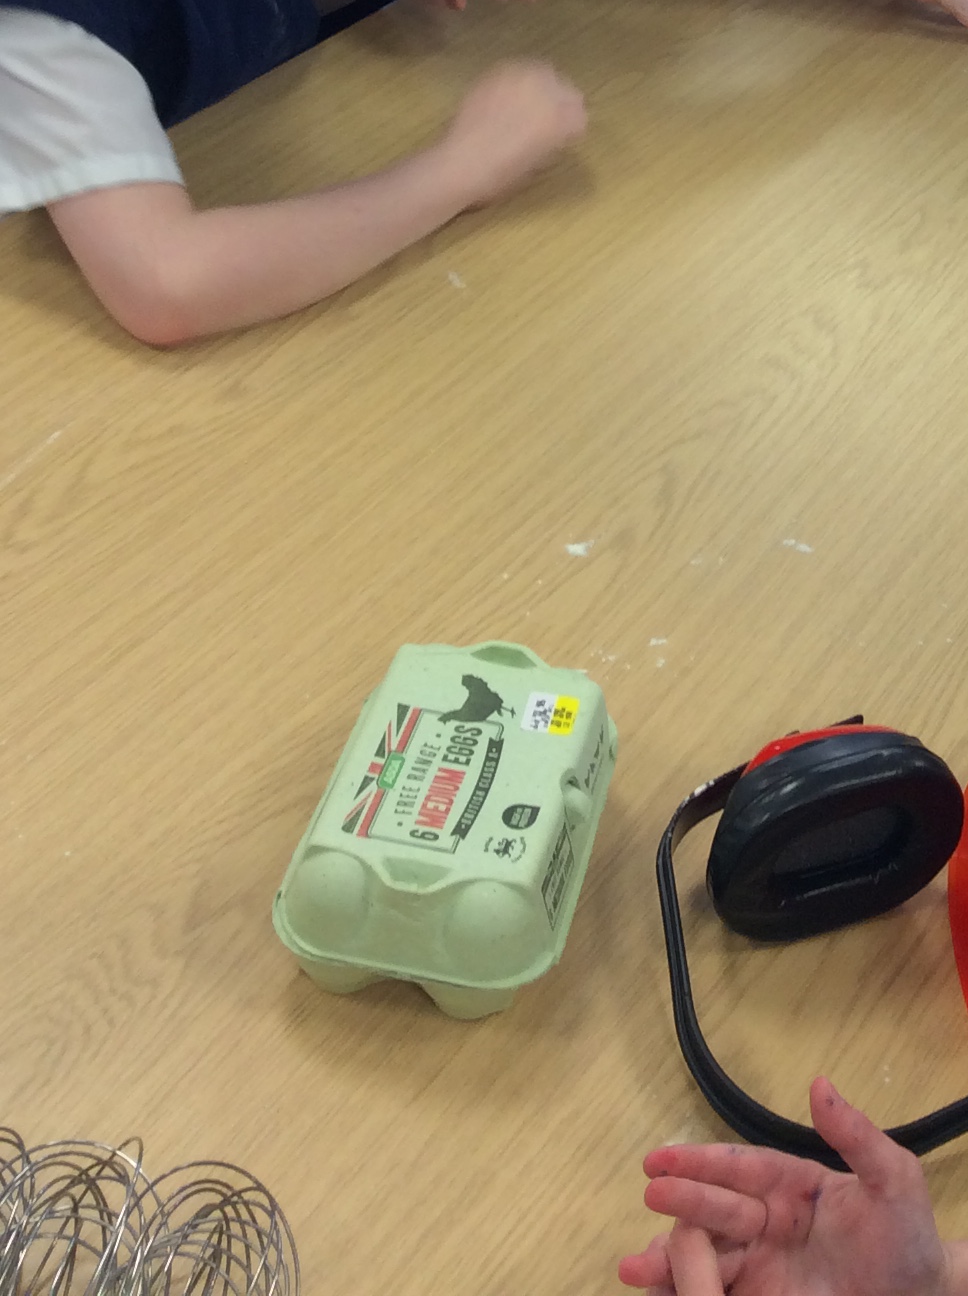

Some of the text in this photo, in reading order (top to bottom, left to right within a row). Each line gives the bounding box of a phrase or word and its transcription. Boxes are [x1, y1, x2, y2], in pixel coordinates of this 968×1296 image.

[394, 742, 441, 815] FREE RANGE
[409, 725, 482, 841] 6 MEDIUM EGGS
[478, 760, 496, 789] CLASS
